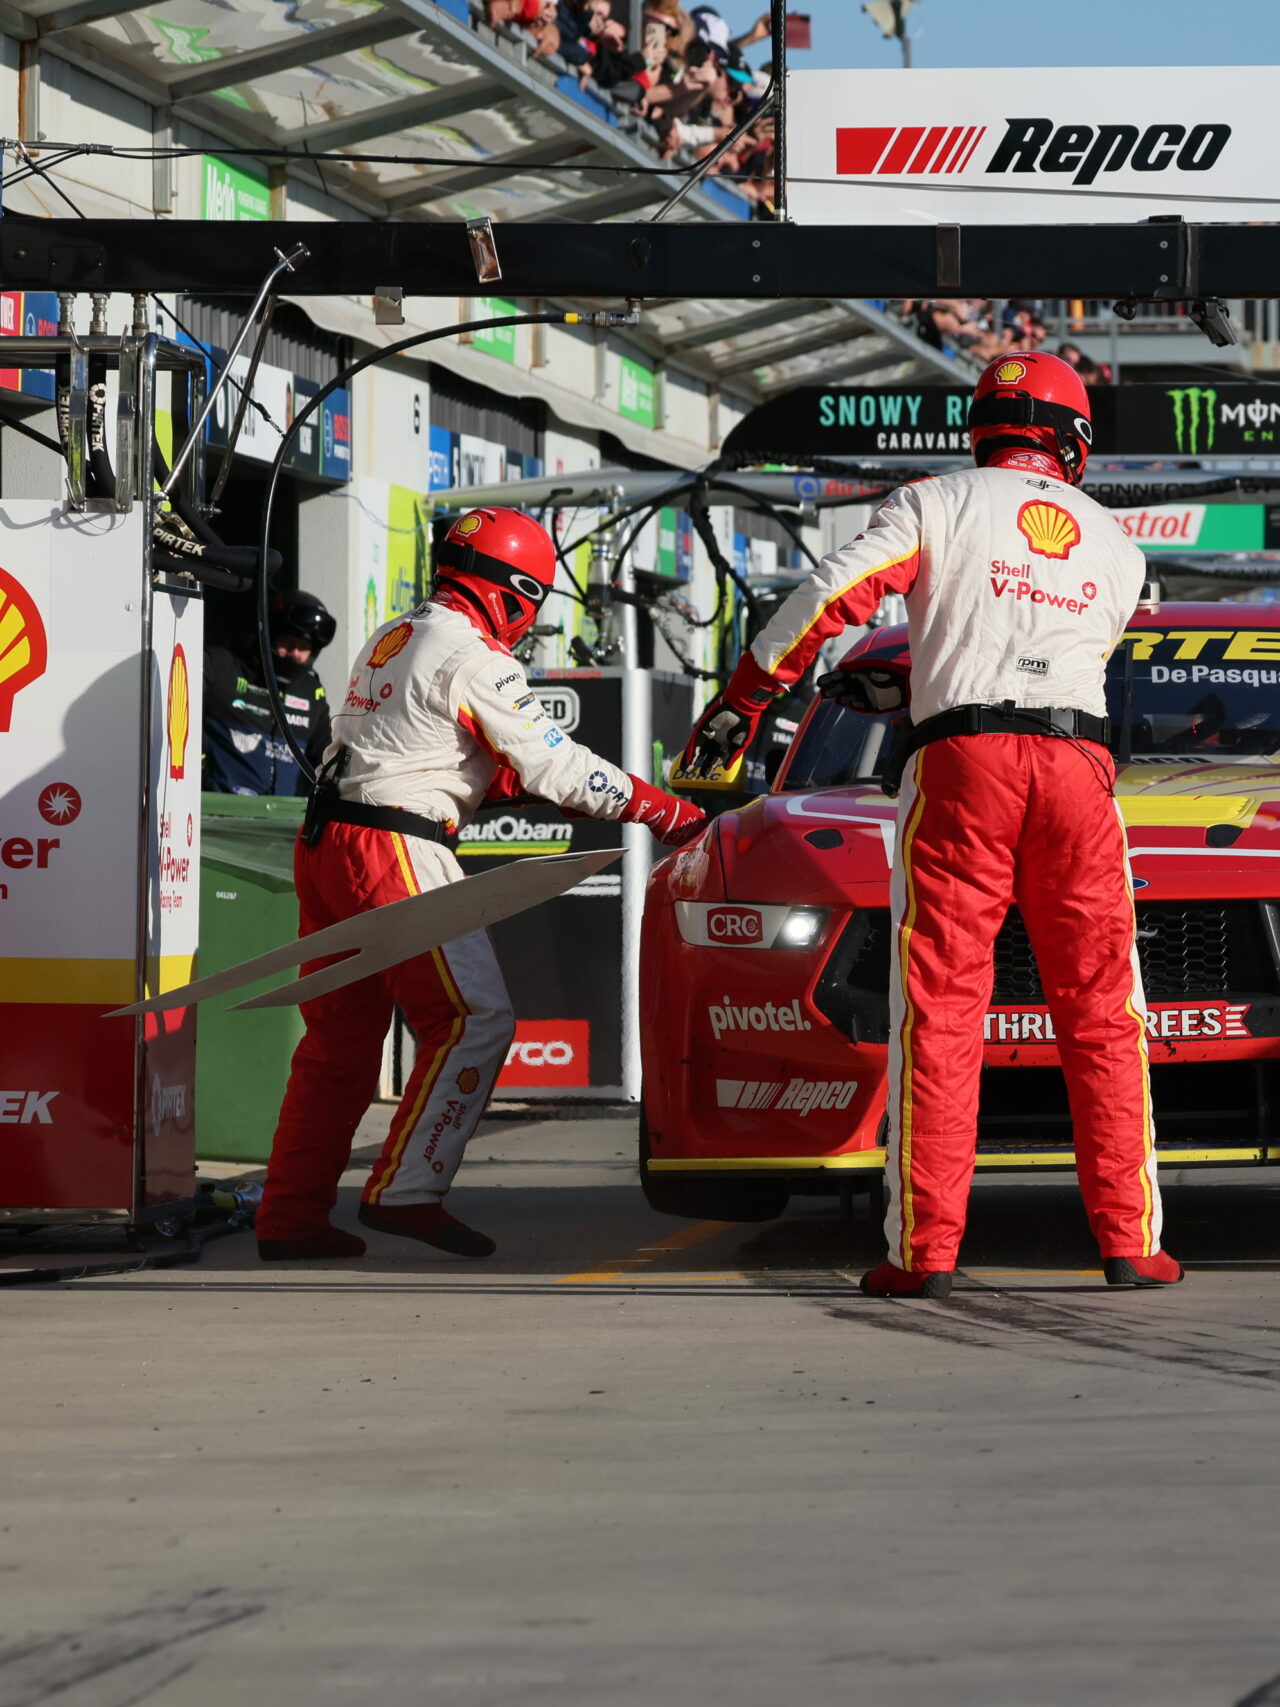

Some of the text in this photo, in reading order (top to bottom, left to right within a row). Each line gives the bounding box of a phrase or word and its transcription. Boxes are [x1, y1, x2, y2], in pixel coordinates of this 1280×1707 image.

[985, 118, 1232, 185] Repco
[819, 395, 923, 428] SNOWY
[877, 432, 970, 450] CARAVANS
[1111, 511, 1192, 539] strol
[153, 527, 207, 557] PIRTEK
[991, 559, 1032, 580] Shell
[990, 577, 1090, 616] V-Power
[1017, 658, 1047, 669] rpm
[1151, 665, 1188, 684] De
[708, 912, 760, 938] CRC
[708, 995, 812, 1040] pivotel.
[983, 1005, 1224, 1041] THRE REES
[774, 1077, 858, 1117] Repco
[452, 1102, 467, 1130] Shell
[423, 1100, 460, 1164] V-Power
